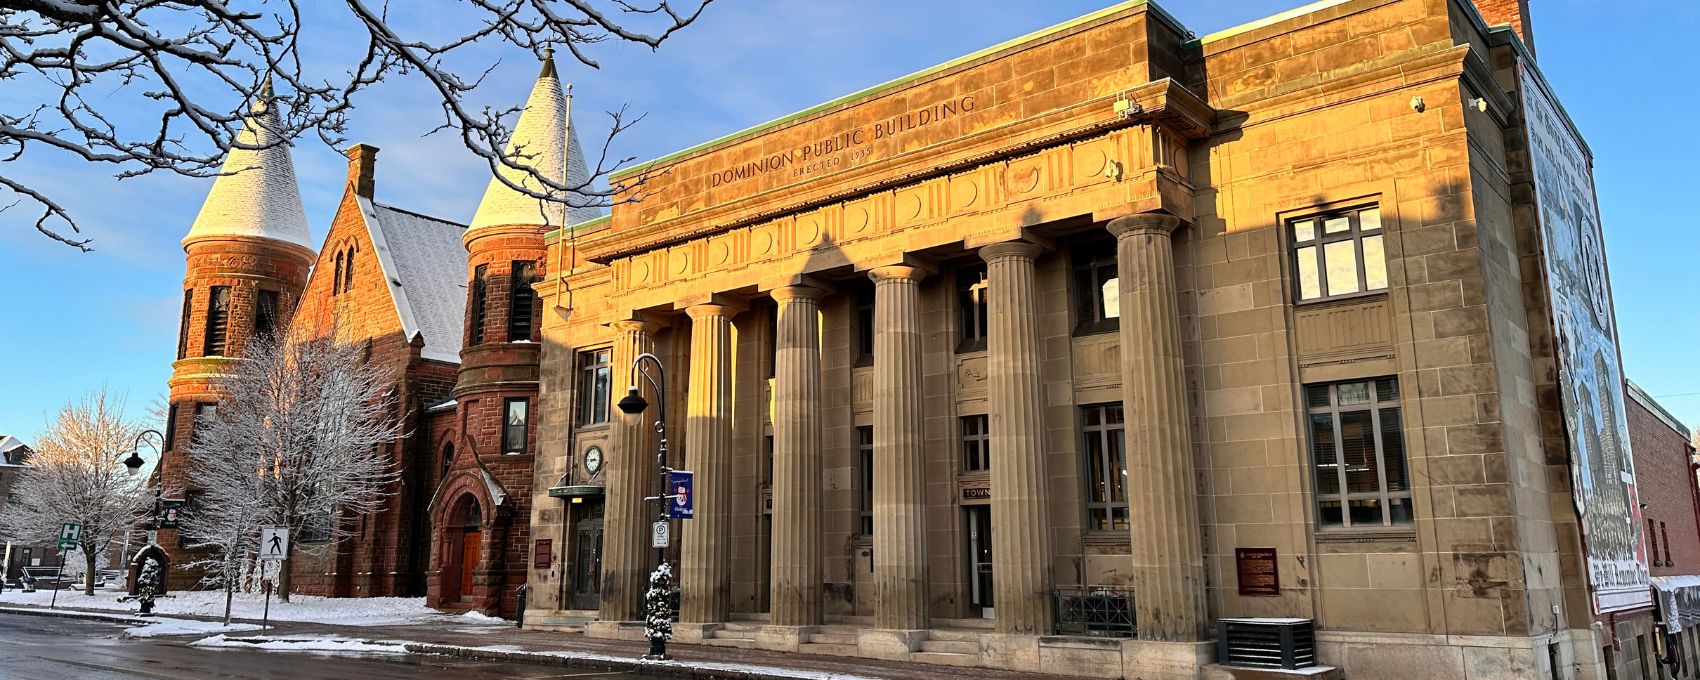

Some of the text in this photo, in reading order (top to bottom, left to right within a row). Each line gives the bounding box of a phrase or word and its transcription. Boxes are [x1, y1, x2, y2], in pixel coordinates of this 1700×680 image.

[712, 96, 974, 188] DOMINION PUBLIC BUILDING
[793, 147, 871, 177] ERECTED 1935
[966, 489, 990, 497] TOWN
[62, 524, 80, 539] H
